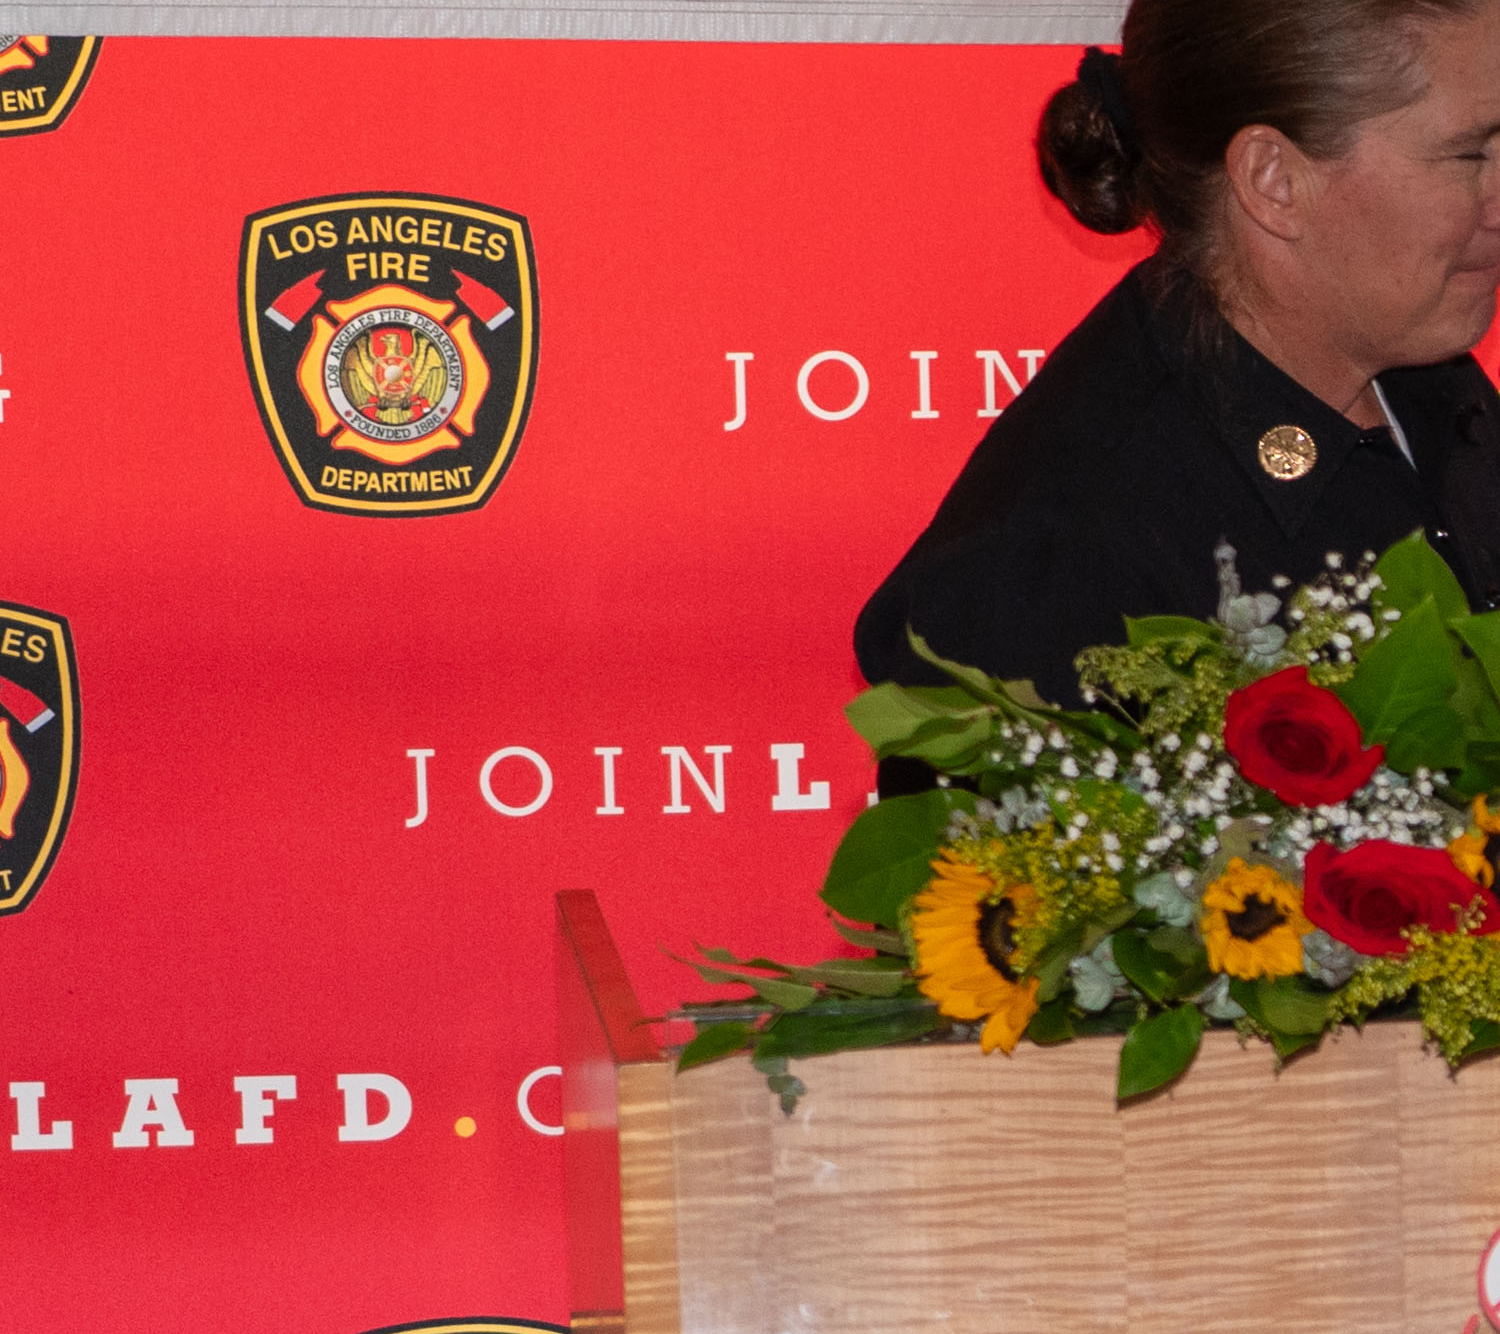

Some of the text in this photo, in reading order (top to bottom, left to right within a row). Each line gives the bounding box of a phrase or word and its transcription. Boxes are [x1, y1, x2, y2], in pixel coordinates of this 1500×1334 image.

[268, 215, 508, 262] LOS ANGELES
[346, 252, 431, 283] FIRE
[331, 314, 376, 361] ANGELES
[380, 310, 411, 323] FIRE
[414, 316, 461, 392] DEPARTMENT
[351, 414, 443, 439] FOUNDED 1886
[320, 465, 473, 494] DEPARTMENT
